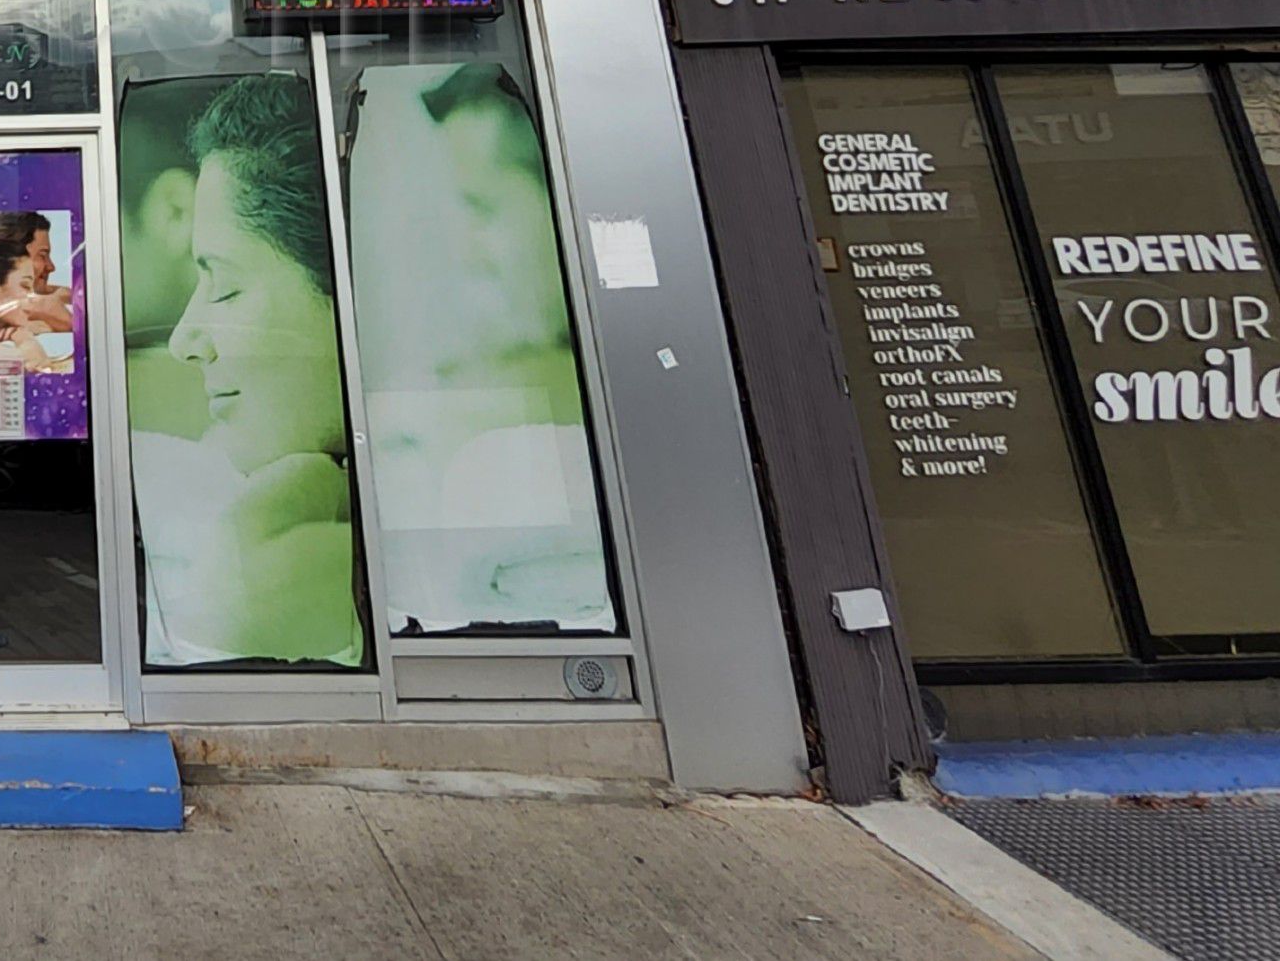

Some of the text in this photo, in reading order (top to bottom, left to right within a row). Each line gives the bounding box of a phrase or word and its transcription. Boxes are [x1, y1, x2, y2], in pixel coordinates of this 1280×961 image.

[818, 133, 919, 153] GENERAL
[823, 153, 936, 173] COSMETIC
[827, 172, 923, 193] IMPLANT
[831, 191, 949, 213] DENTISTRY
[847, 241, 925, 258] crowns
[1052, 233, 1262, 275] REDEFINE
[851, 260, 933, 281] bridges
[856, 283, 942, 299] veneers
[863, 302, 960, 324] implants
[1077, 295, 1271, 343] YOUR
[868, 322, 976, 347] invisalign
[873, 344, 964, 364] orthoFX
[880, 364, 1003, 386] root canals
[1094, 346, 1280, 422] smile
[885, 389, 1018, 410] oral surgery
[890, 411, 960, 431] teeth-
[894, 432, 1009, 455] whitening
[901, 455, 988, 477] & more!
